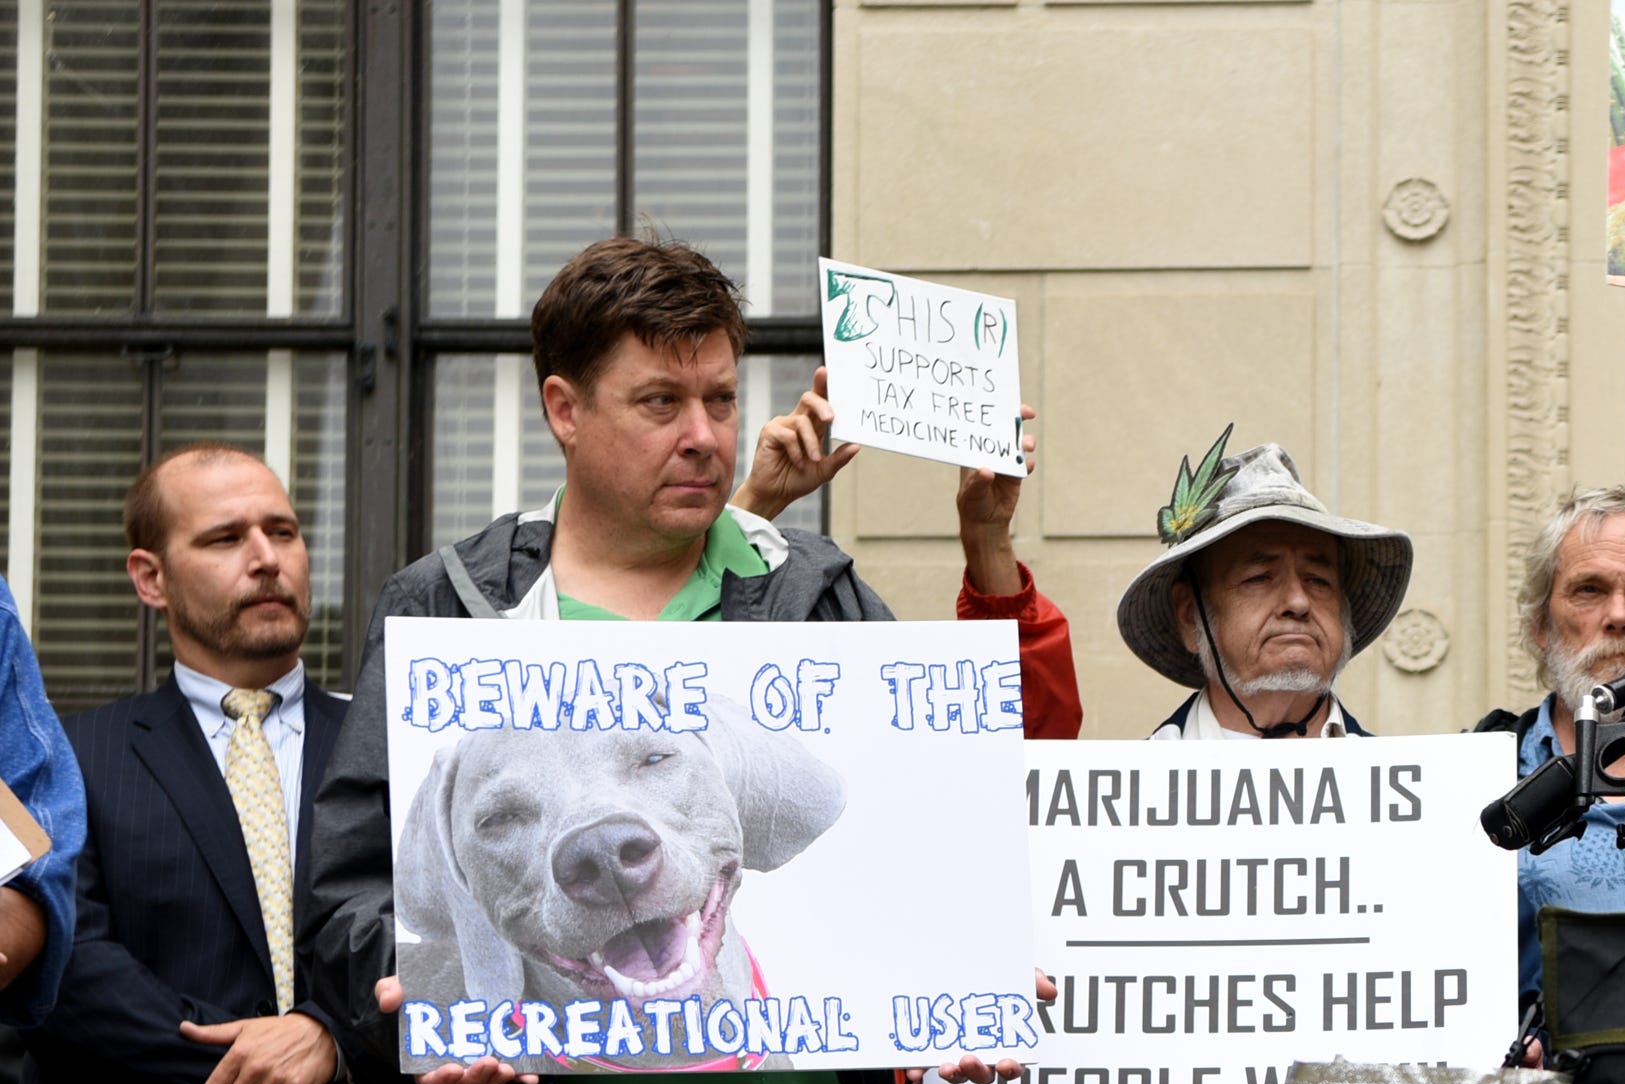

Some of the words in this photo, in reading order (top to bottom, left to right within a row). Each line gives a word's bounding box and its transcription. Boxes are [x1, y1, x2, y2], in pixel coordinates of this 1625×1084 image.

[827, 268, 956, 343] THIS
[974, 302, 1007, 358] (R)
[865, 341, 996, 393] SUPPORTS
[861, 409, 959, 448] MEDICINE
[870, 376, 915, 410] TAX
[932, 392, 996, 427] FREE
[402, 657, 710, 735] BEWARE
[750, 658, 842, 735] OF
[880, 658, 1024, 735] THE
[1370, 764, 1422, 823] IS
[1051, 859, 1087, 917] A
[1112, 856, 1383, 917] CRUTCH..
[402, 993, 860, 1056] RECREATIONAL
[890, 993, 1039, 1053] USER
[1036, 974, 1297, 1034] UTCHES
[1323, 968, 1468, 1032] HELP
